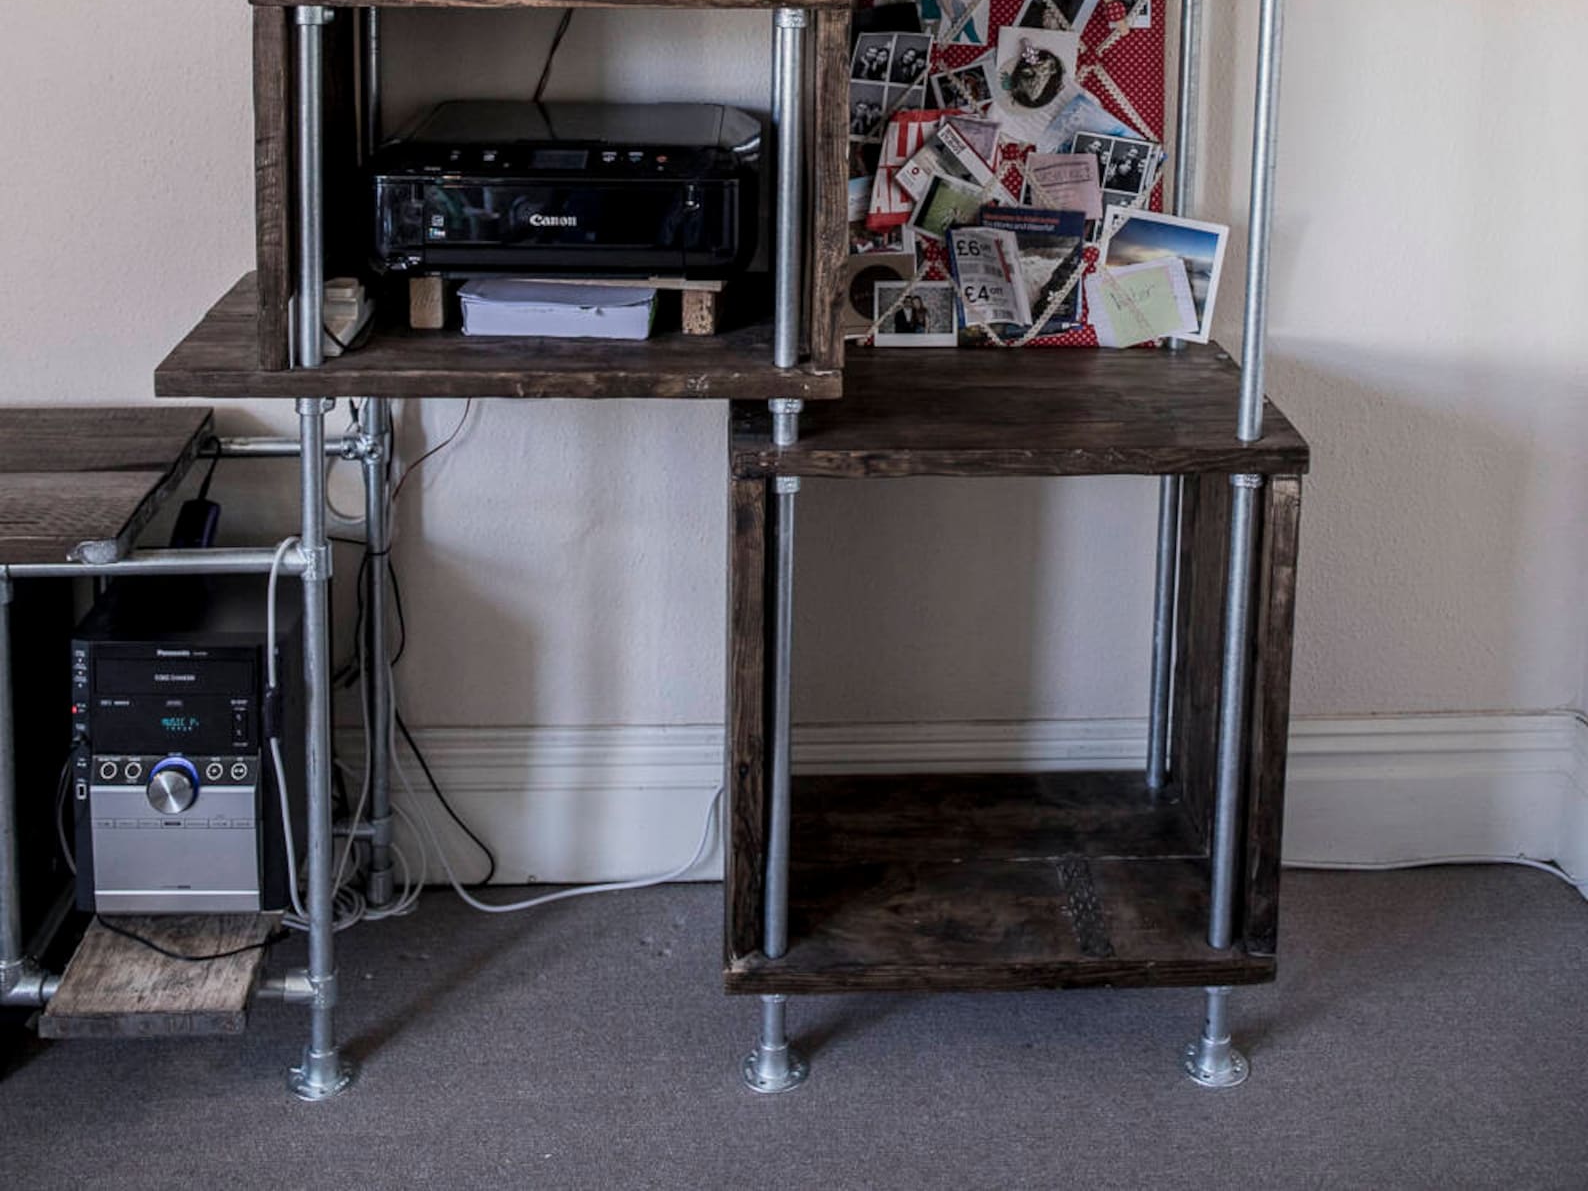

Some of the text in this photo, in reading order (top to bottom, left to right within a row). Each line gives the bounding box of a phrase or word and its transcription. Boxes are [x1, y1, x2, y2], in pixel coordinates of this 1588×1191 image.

[529, 213, 578, 227] Canon
[956, 240, 981, 256] £6
[964, 285, 990, 303] £4
